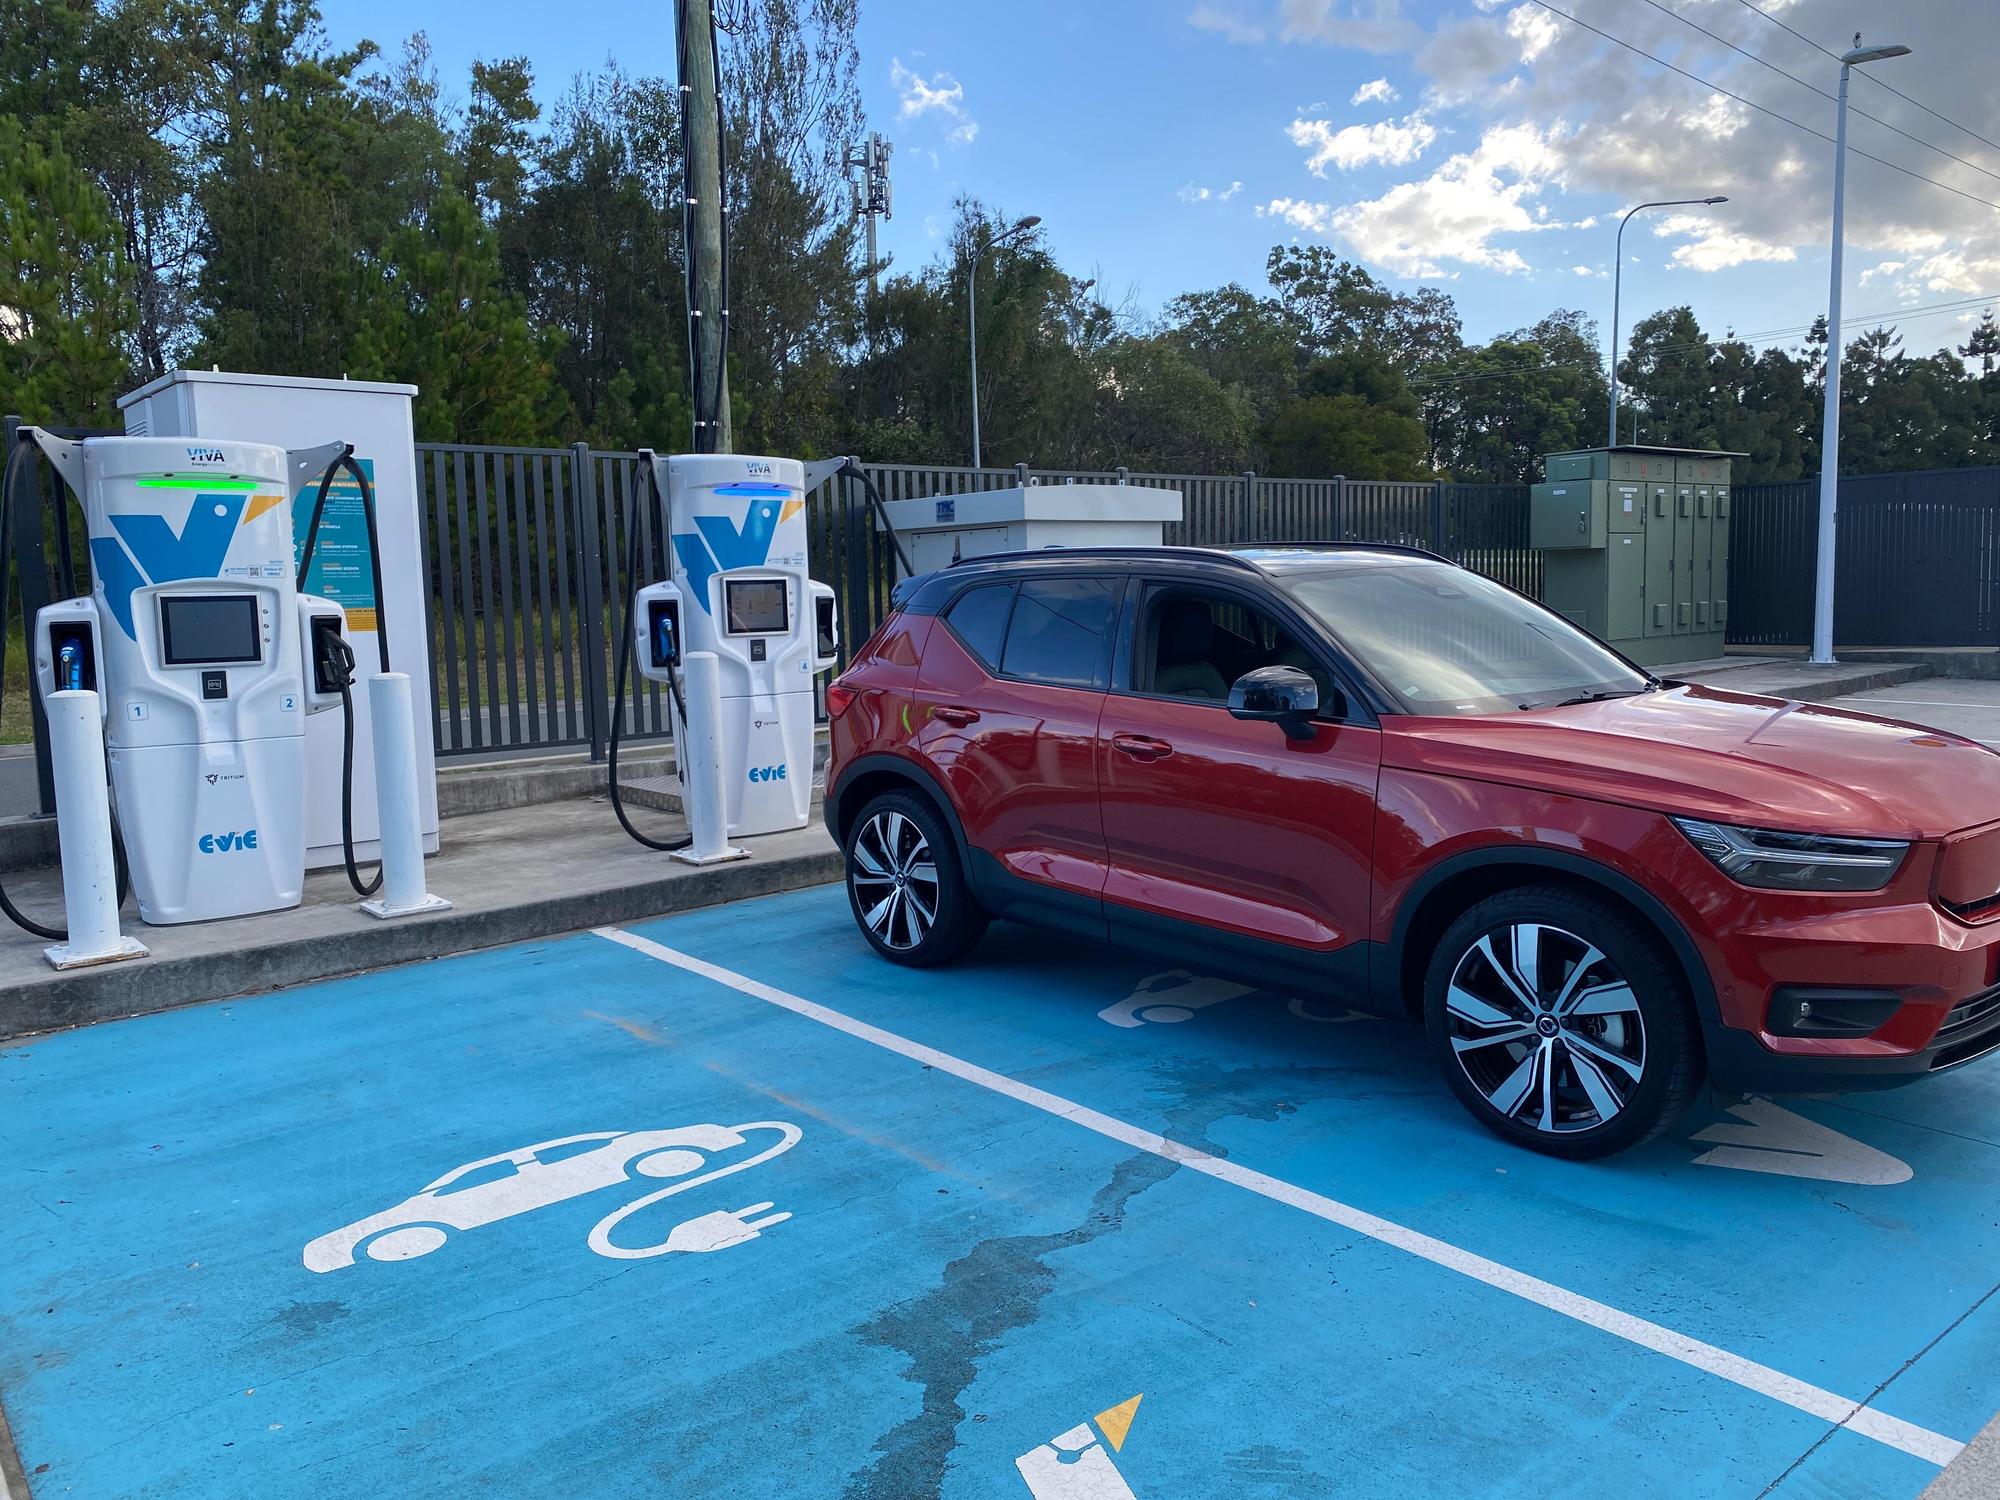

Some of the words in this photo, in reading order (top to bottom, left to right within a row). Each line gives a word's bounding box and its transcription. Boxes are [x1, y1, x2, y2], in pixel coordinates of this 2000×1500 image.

[187, 448, 225, 462] VIVA
[746, 462, 771, 473] VIVA
[936, 500, 954, 513] TMC
[802, 662, 808, 671] 4
[286, 698, 294, 708] 2
[134, 706, 141, 716] 1
